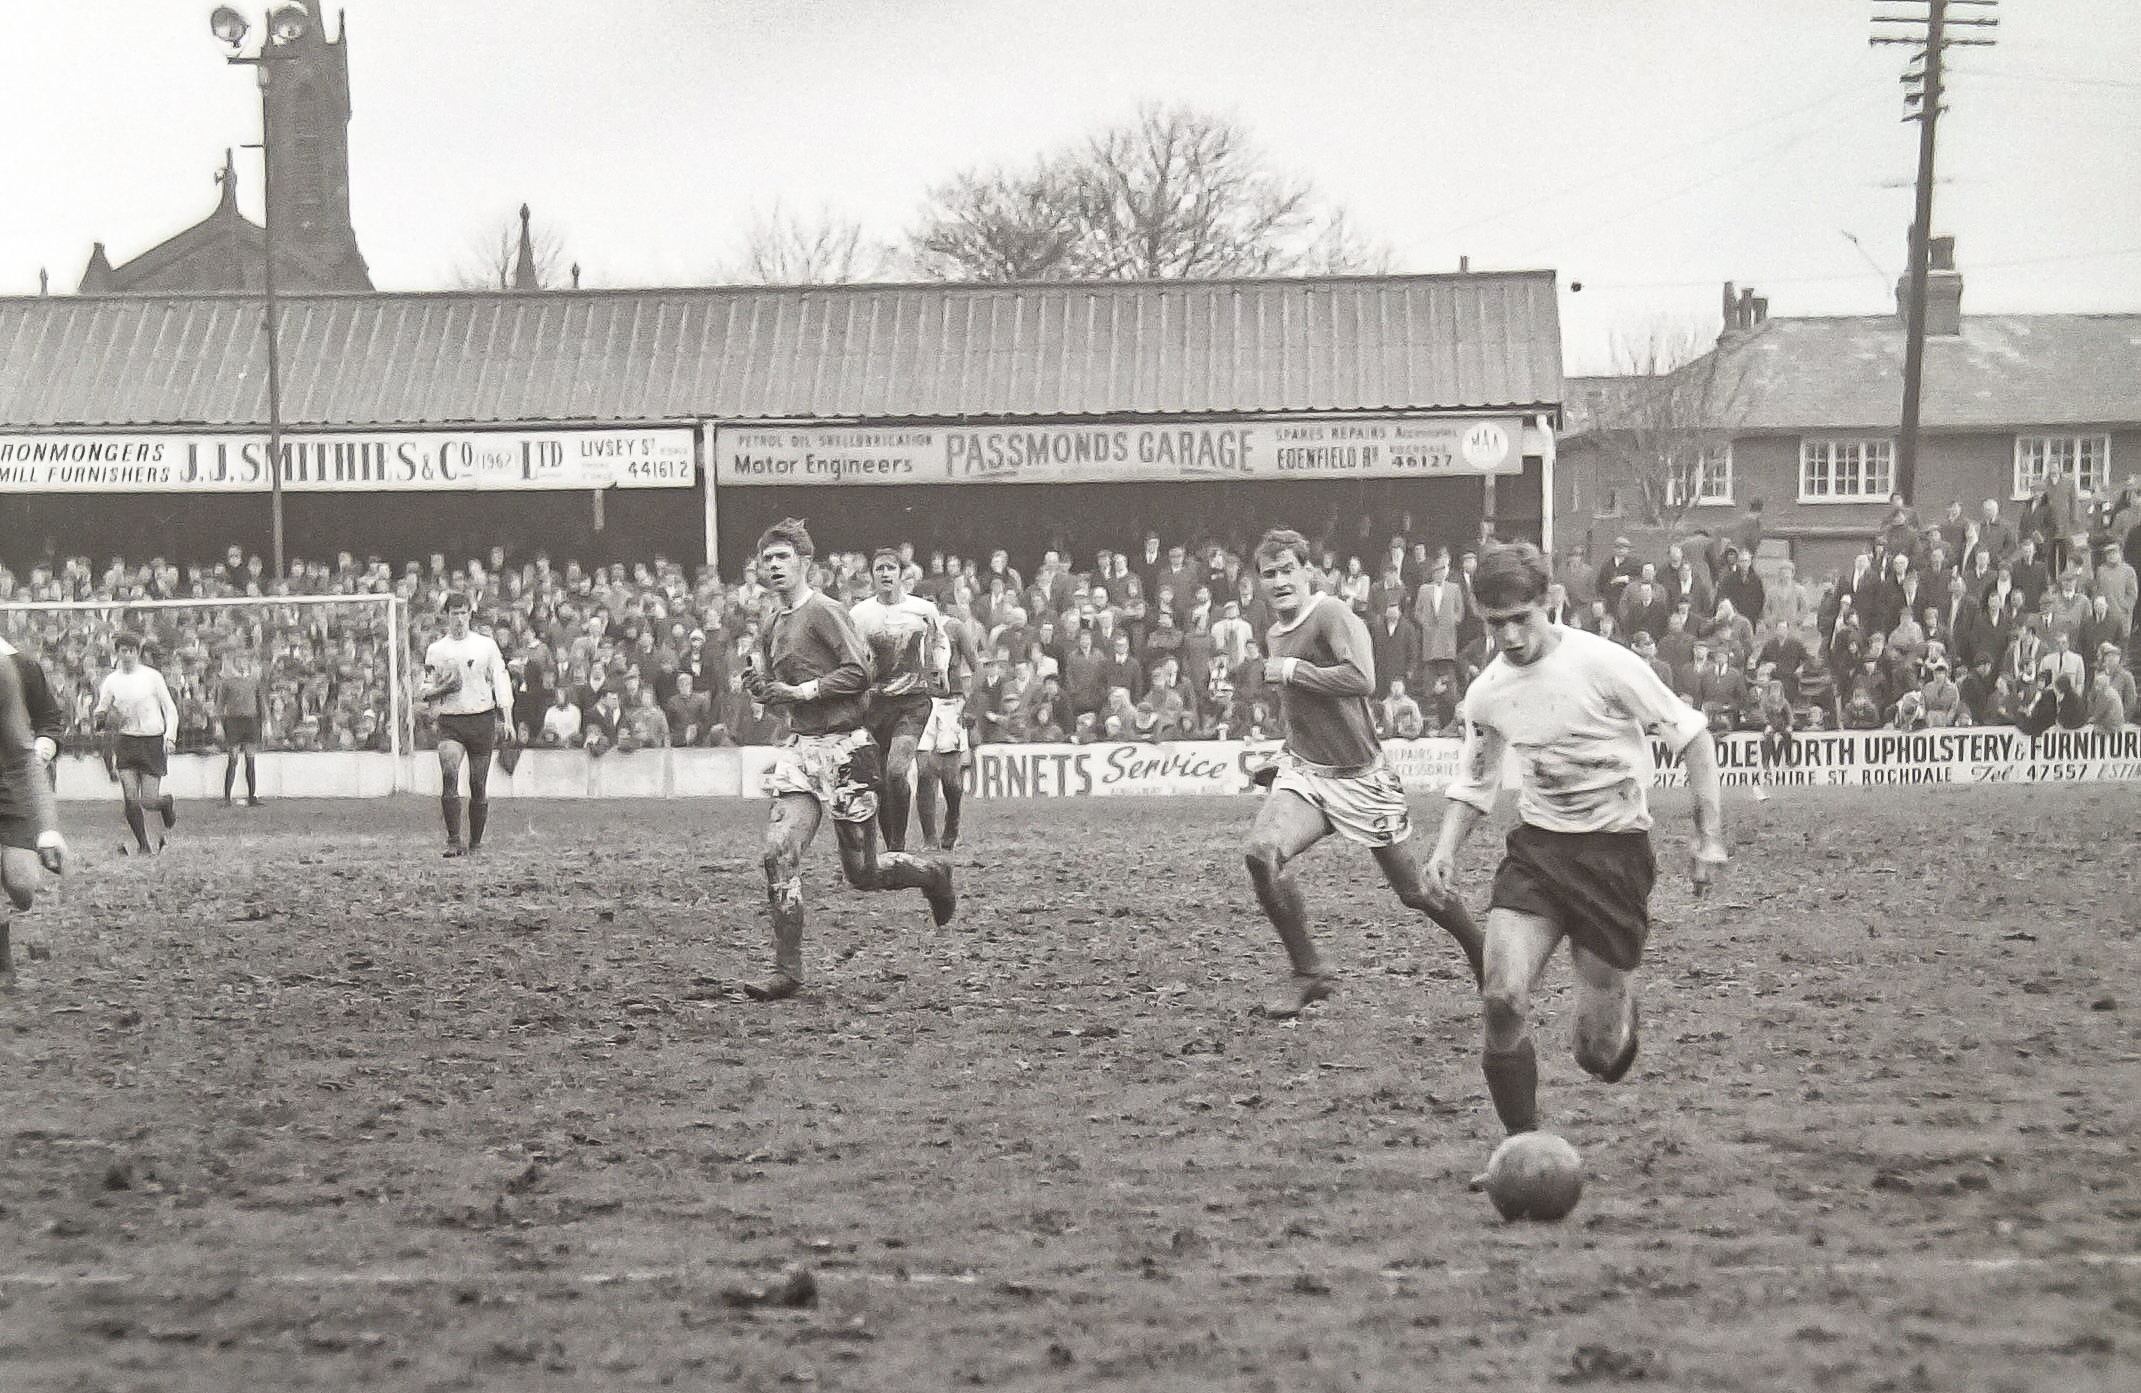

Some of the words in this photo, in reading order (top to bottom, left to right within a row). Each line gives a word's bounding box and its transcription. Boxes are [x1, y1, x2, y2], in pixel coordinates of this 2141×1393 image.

[946, 431, 1129, 476] PASSMONDS
[1137, 430, 1254, 472] GARAGE
[1277, 446, 1356, 469] EDENFIELD
[1391, 454, 1452, 467] 46127
[0, 466, 37, 483] MILL
[48, 466, 170, 483] FURNISHERS
[735, 454, 798, 475] Motor
[806, 453, 913, 480] Engineers
[1864, 734, 2014, 765] UPHOLSTERY
[1102, 746, 1228, 783] Service
[1719, 770, 1817, 787] YORKSHIRE
[1862, 766, 1952, 785] ROCHDALE
[2026, 764, 2088, 781] 47557
